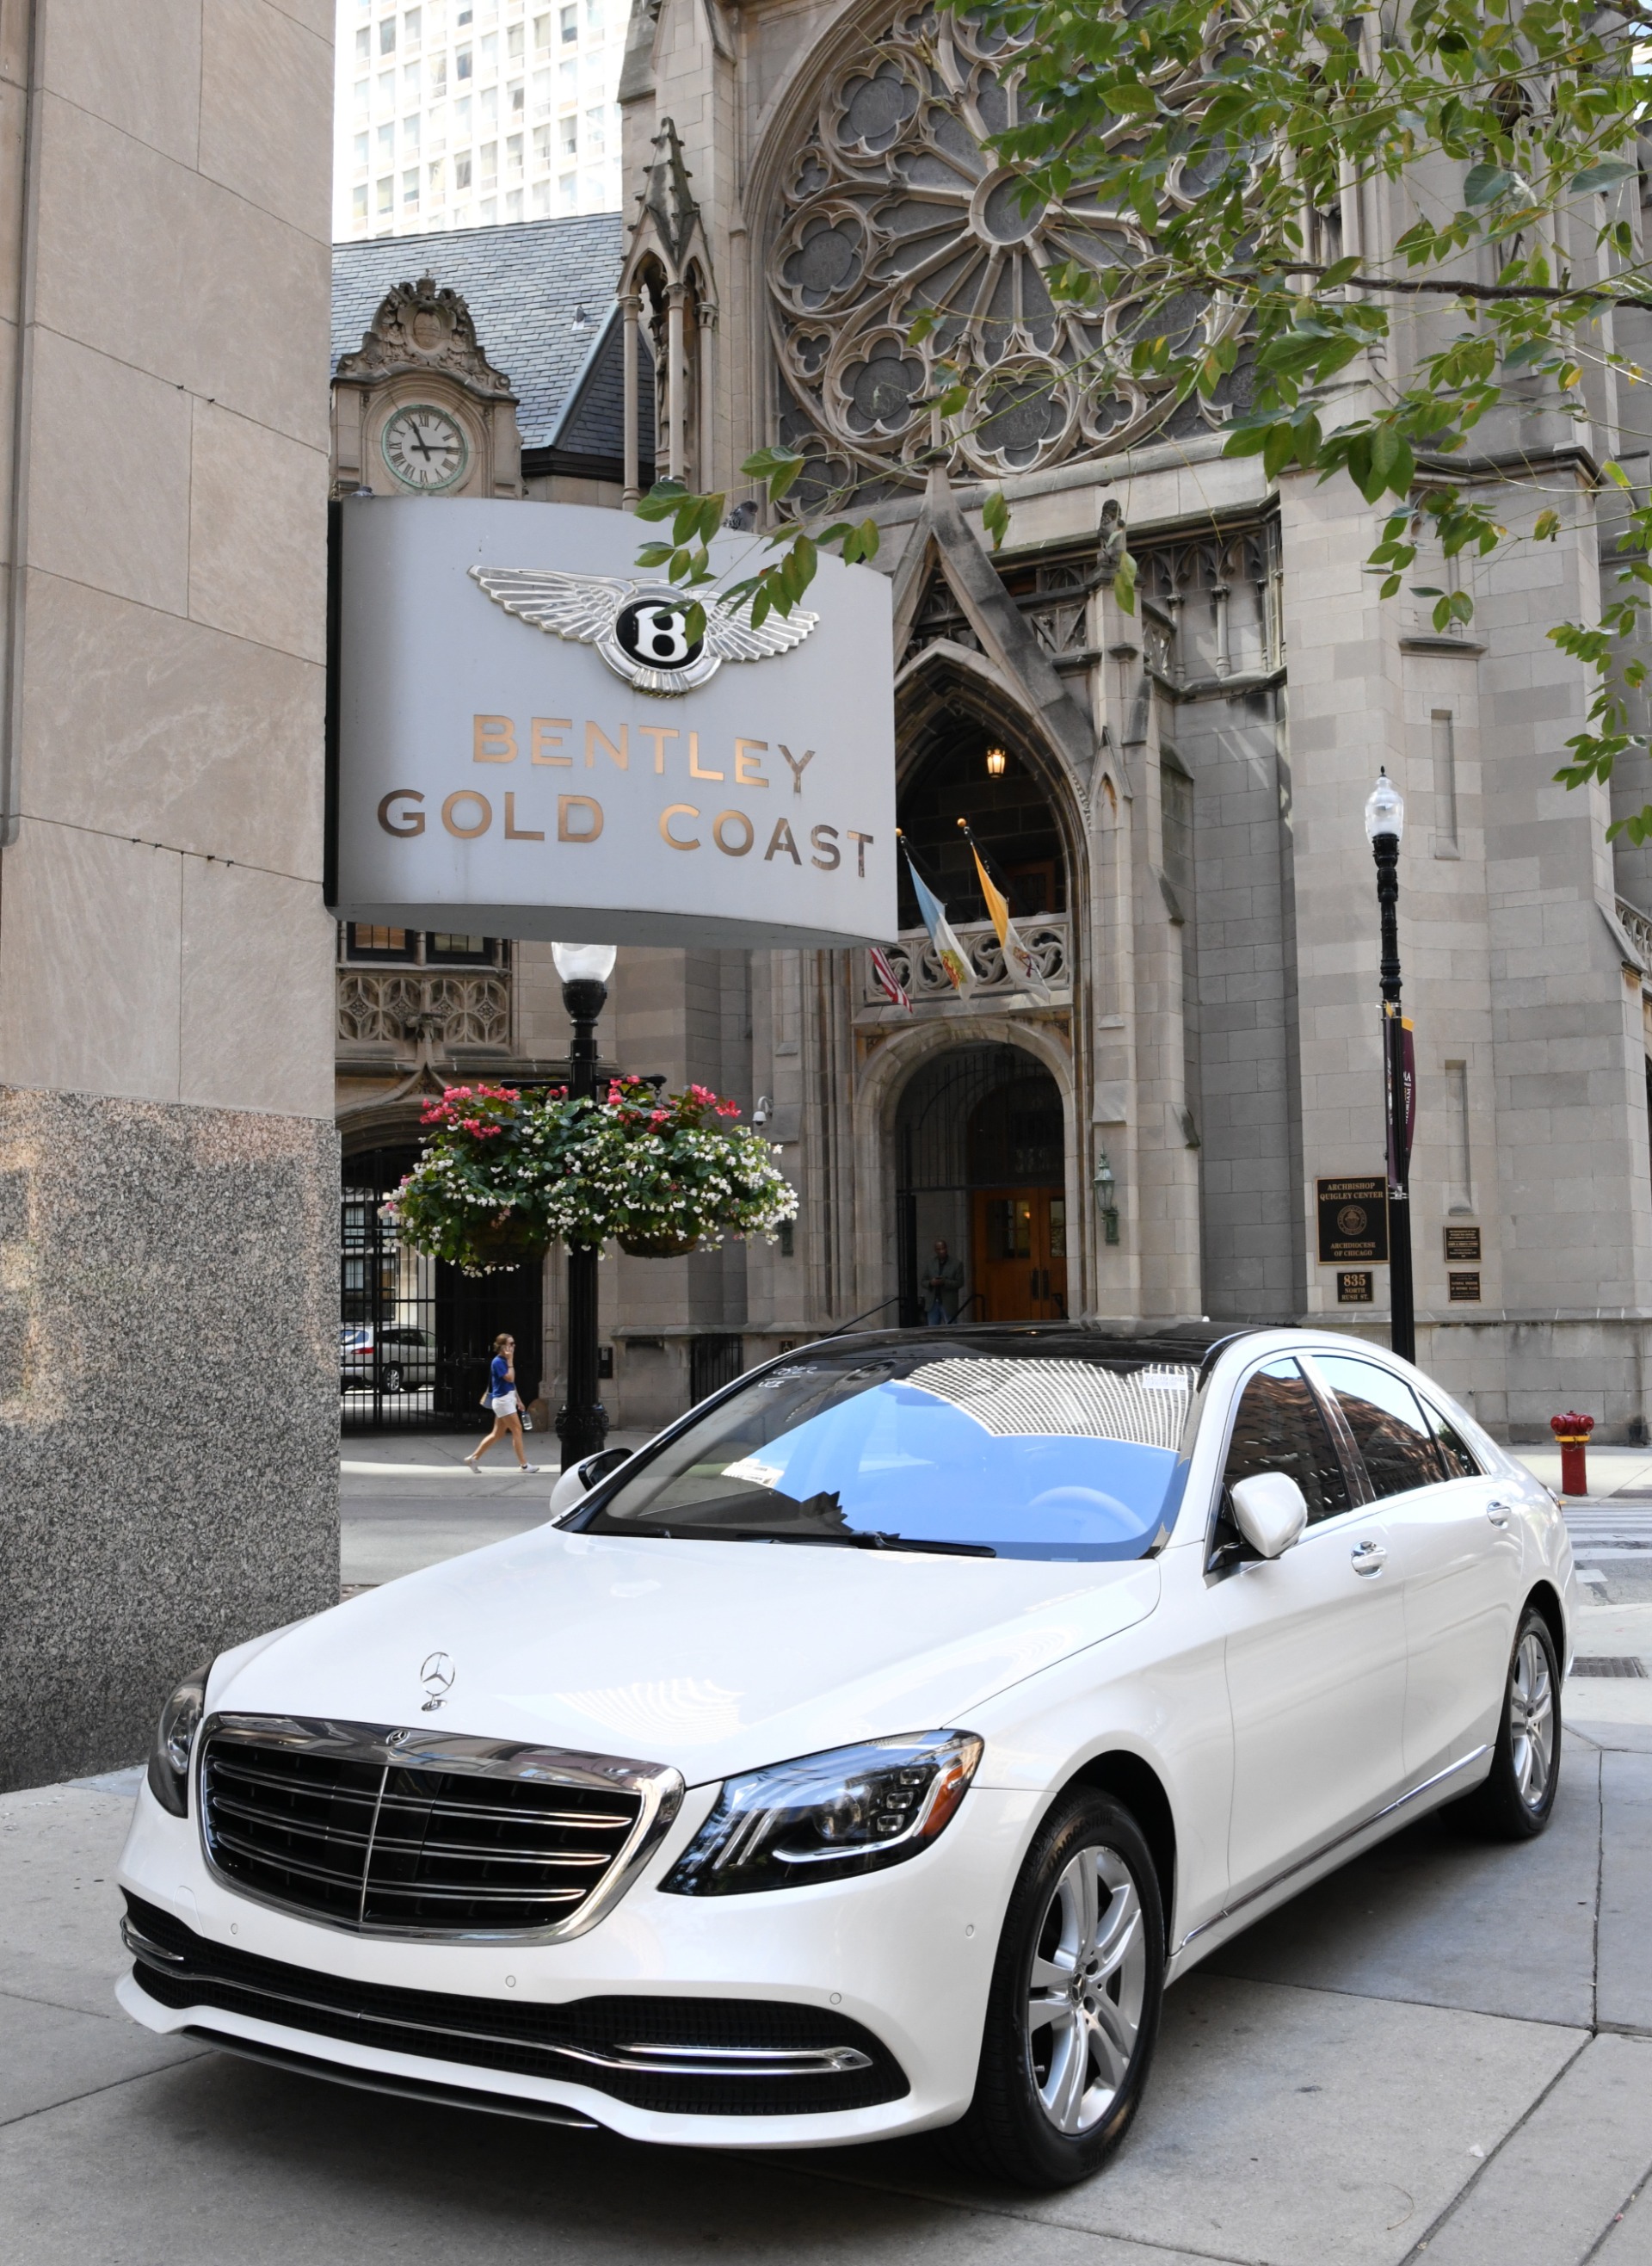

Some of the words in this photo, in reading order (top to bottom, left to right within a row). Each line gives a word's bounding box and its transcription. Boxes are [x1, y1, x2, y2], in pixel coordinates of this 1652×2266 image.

[472, 714, 816, 793] BENTLEY
[377, 788, 604, 844] GOLD
[659, 803, 875, 878] COAST
[1327, 1182, 1375, 1191] ARCHBISHOP
[1320, 1192, 1353, 1201] QUIGLEY
[1343, 1274, 1366, 1287] 835
